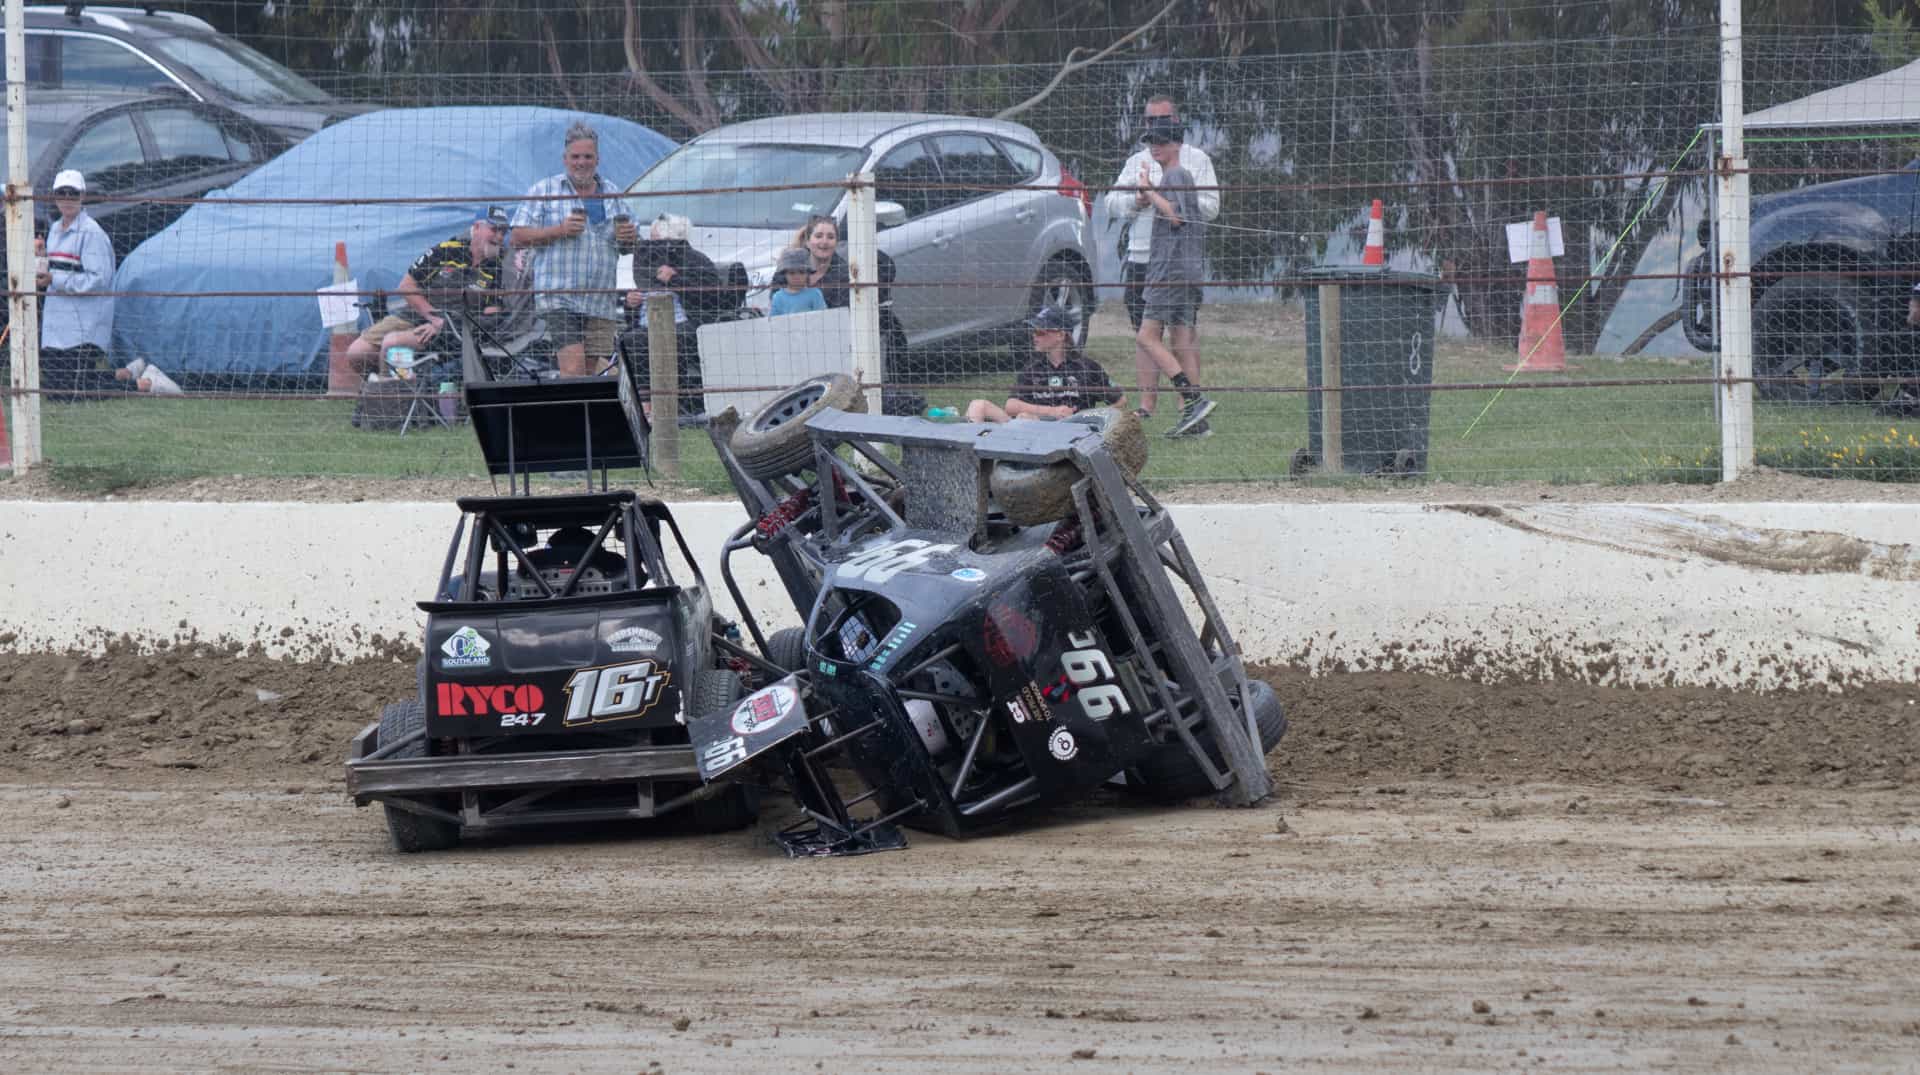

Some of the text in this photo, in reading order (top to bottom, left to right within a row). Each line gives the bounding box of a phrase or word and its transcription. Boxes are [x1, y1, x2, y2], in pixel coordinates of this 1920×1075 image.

[1409, 331, 1421, 376] 8
[442, 656, 490, 666] SOUTHLAND
[437, 682, 544, 716] RYCO
